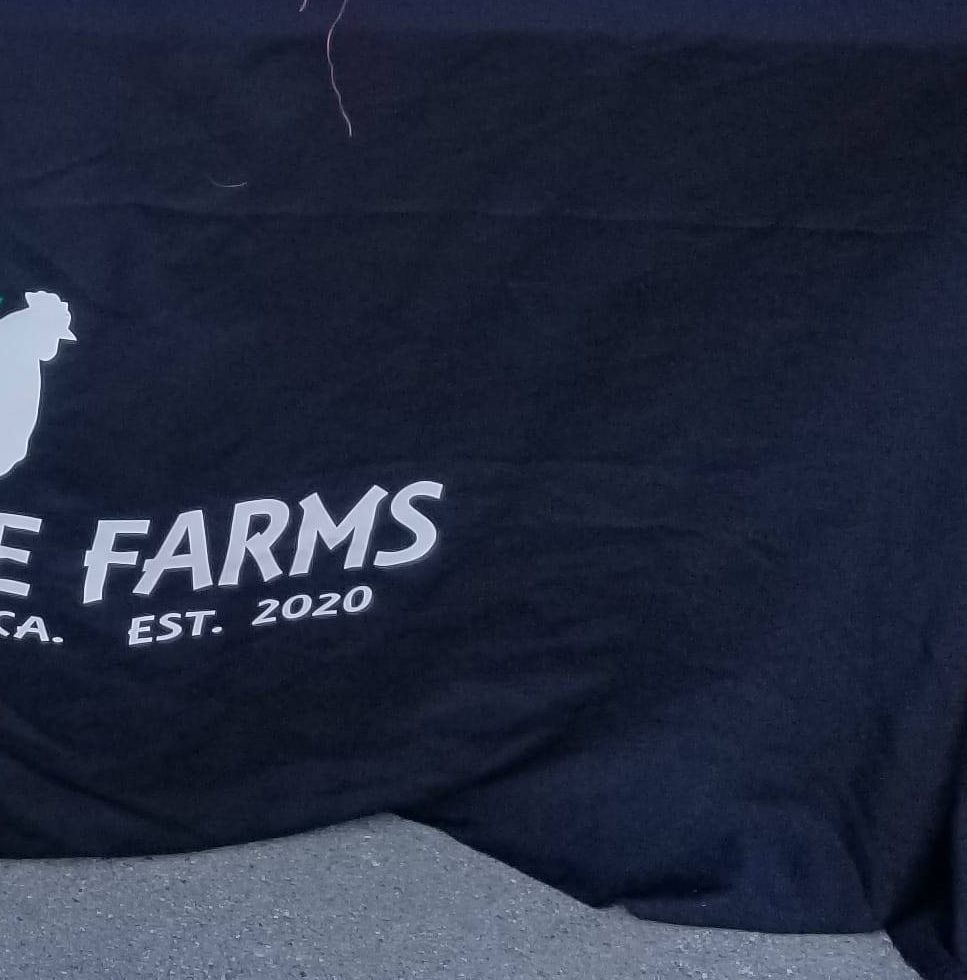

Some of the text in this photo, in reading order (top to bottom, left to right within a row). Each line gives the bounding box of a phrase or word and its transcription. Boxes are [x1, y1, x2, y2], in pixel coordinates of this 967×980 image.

[82, 480, 444, 606] FARMS
[126, 609, 223, 647] EST.
[250, 584, 374, 627] 2020
